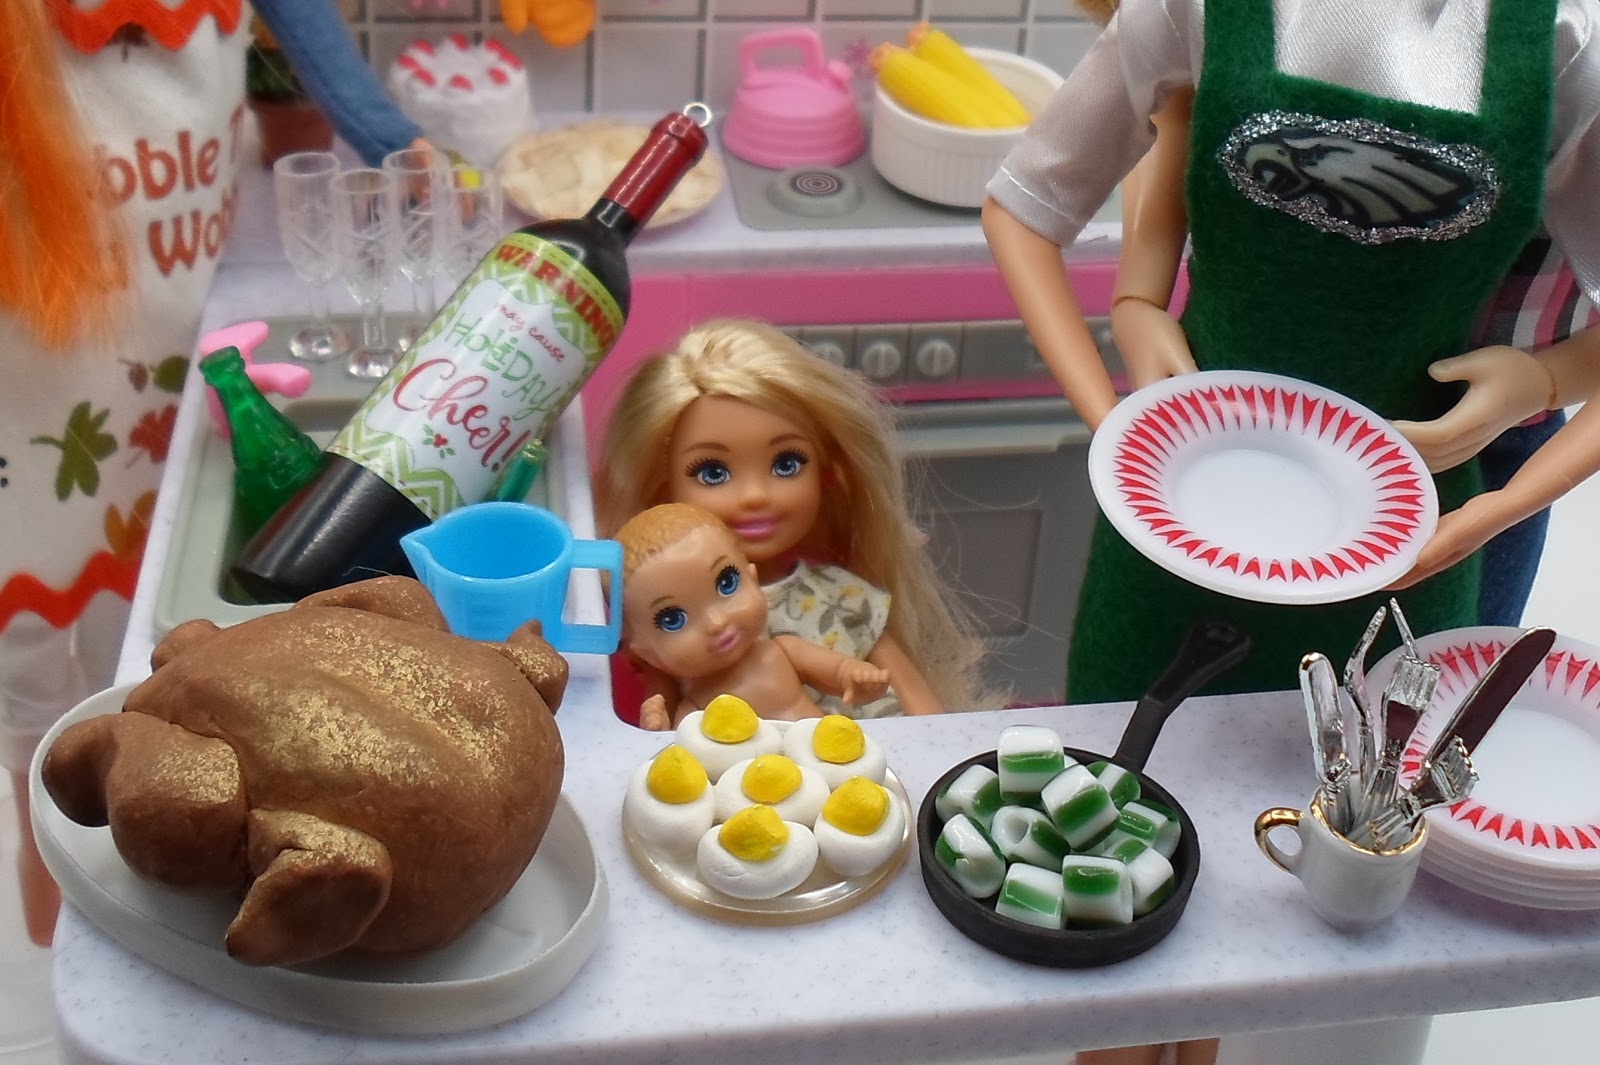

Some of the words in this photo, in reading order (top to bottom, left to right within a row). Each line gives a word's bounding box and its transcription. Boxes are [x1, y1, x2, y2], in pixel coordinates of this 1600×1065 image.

[93, 130, 220, 206] bble
[494, 302, 526, 333] may
[528, 326, 565, 363] cause
[496, 244, 617, 349] WARNING
[392, 358, 531, 473] Cheer!
